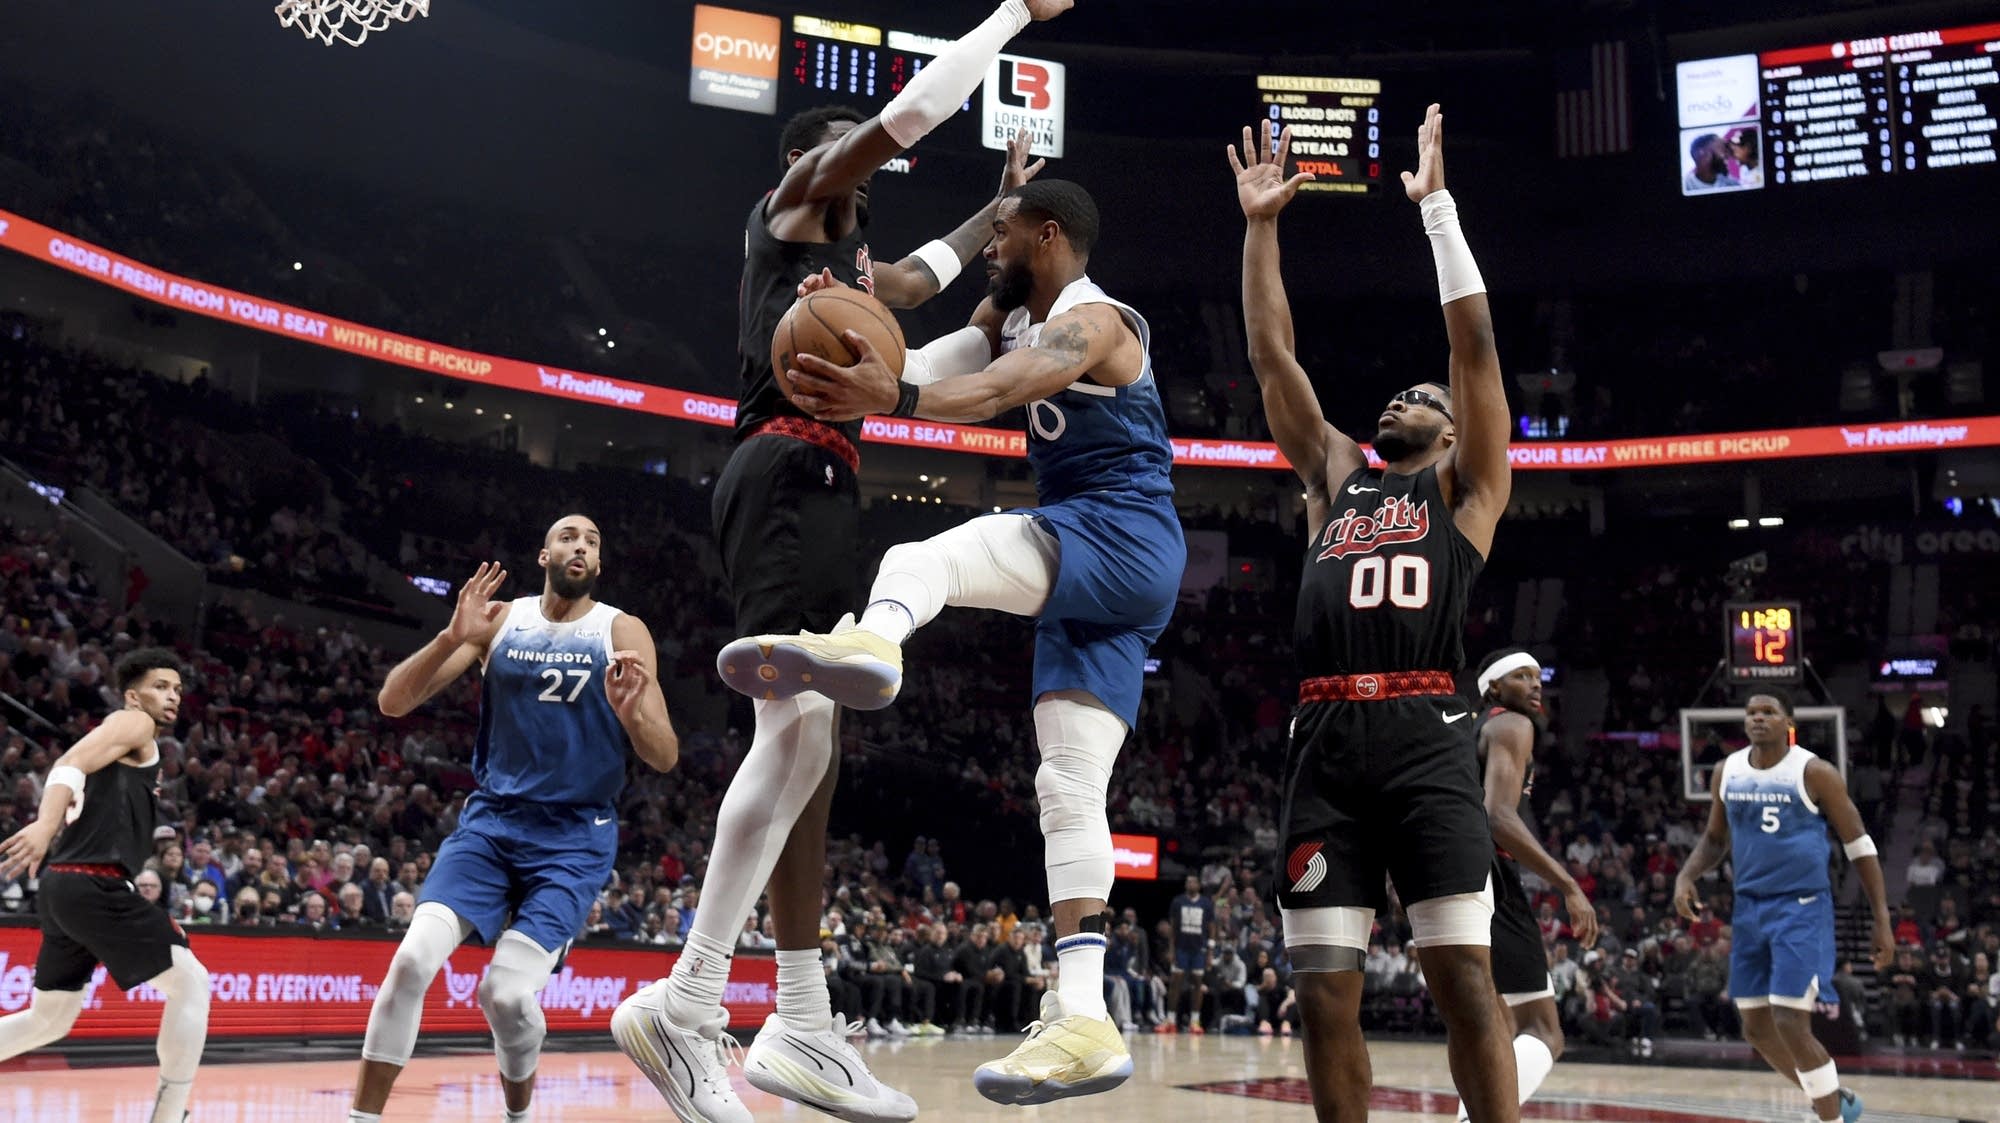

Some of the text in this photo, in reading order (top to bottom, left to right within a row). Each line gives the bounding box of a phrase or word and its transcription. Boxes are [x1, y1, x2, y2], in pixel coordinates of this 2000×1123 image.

[694, 31, 777, 62] opnw
[995, 112, 1053, 131] LORENTZ
[1291, 143, 1348, 156] STEALS
[1296, 161, 1343, 176] TOTAL
[49, 238, 109, 275] ORDER
[112, 261, 165, 297] FRESH
[168, 283, 225, 313] FROM
[227, 298, 279, 326] YOUR
[283, 313, 328, 338] SEAT
[332, 326, 378, 351] WITH
[381, 338, 425, 363] FREE
[428, 349, 492, 376] PICKUP
[863, 420, 910, 440] YOUR
[913, 426, 955, 445] SEAT
[960, 431, 1005, 450] WITH
[1507, 447, 1557, 463] YOUR
[1561, 446, 1607, 463] SEAT
[1613, 443, 1662, 461] WITH
[1668, 441, 1715, 458] FREE
[1720, 435, 1790, 455] PICKUP
[1350, 554, 1430, 609] 00
[1741, 608, 1791, 631] 11:28
[507, 648, 592, 664] MINNESOTA
[1754, 629, 1786, 663] 12
[538, 668, 592, 703] 27
[1727, 791, 1791, 803] MINNESOTA
[1760, 805, 1781, 834] 5
[209, 974, 252, 1000] FOR
[255, 975, 362, 1002] EVERYONE
[536, 967, 626, 1018] Meyer
